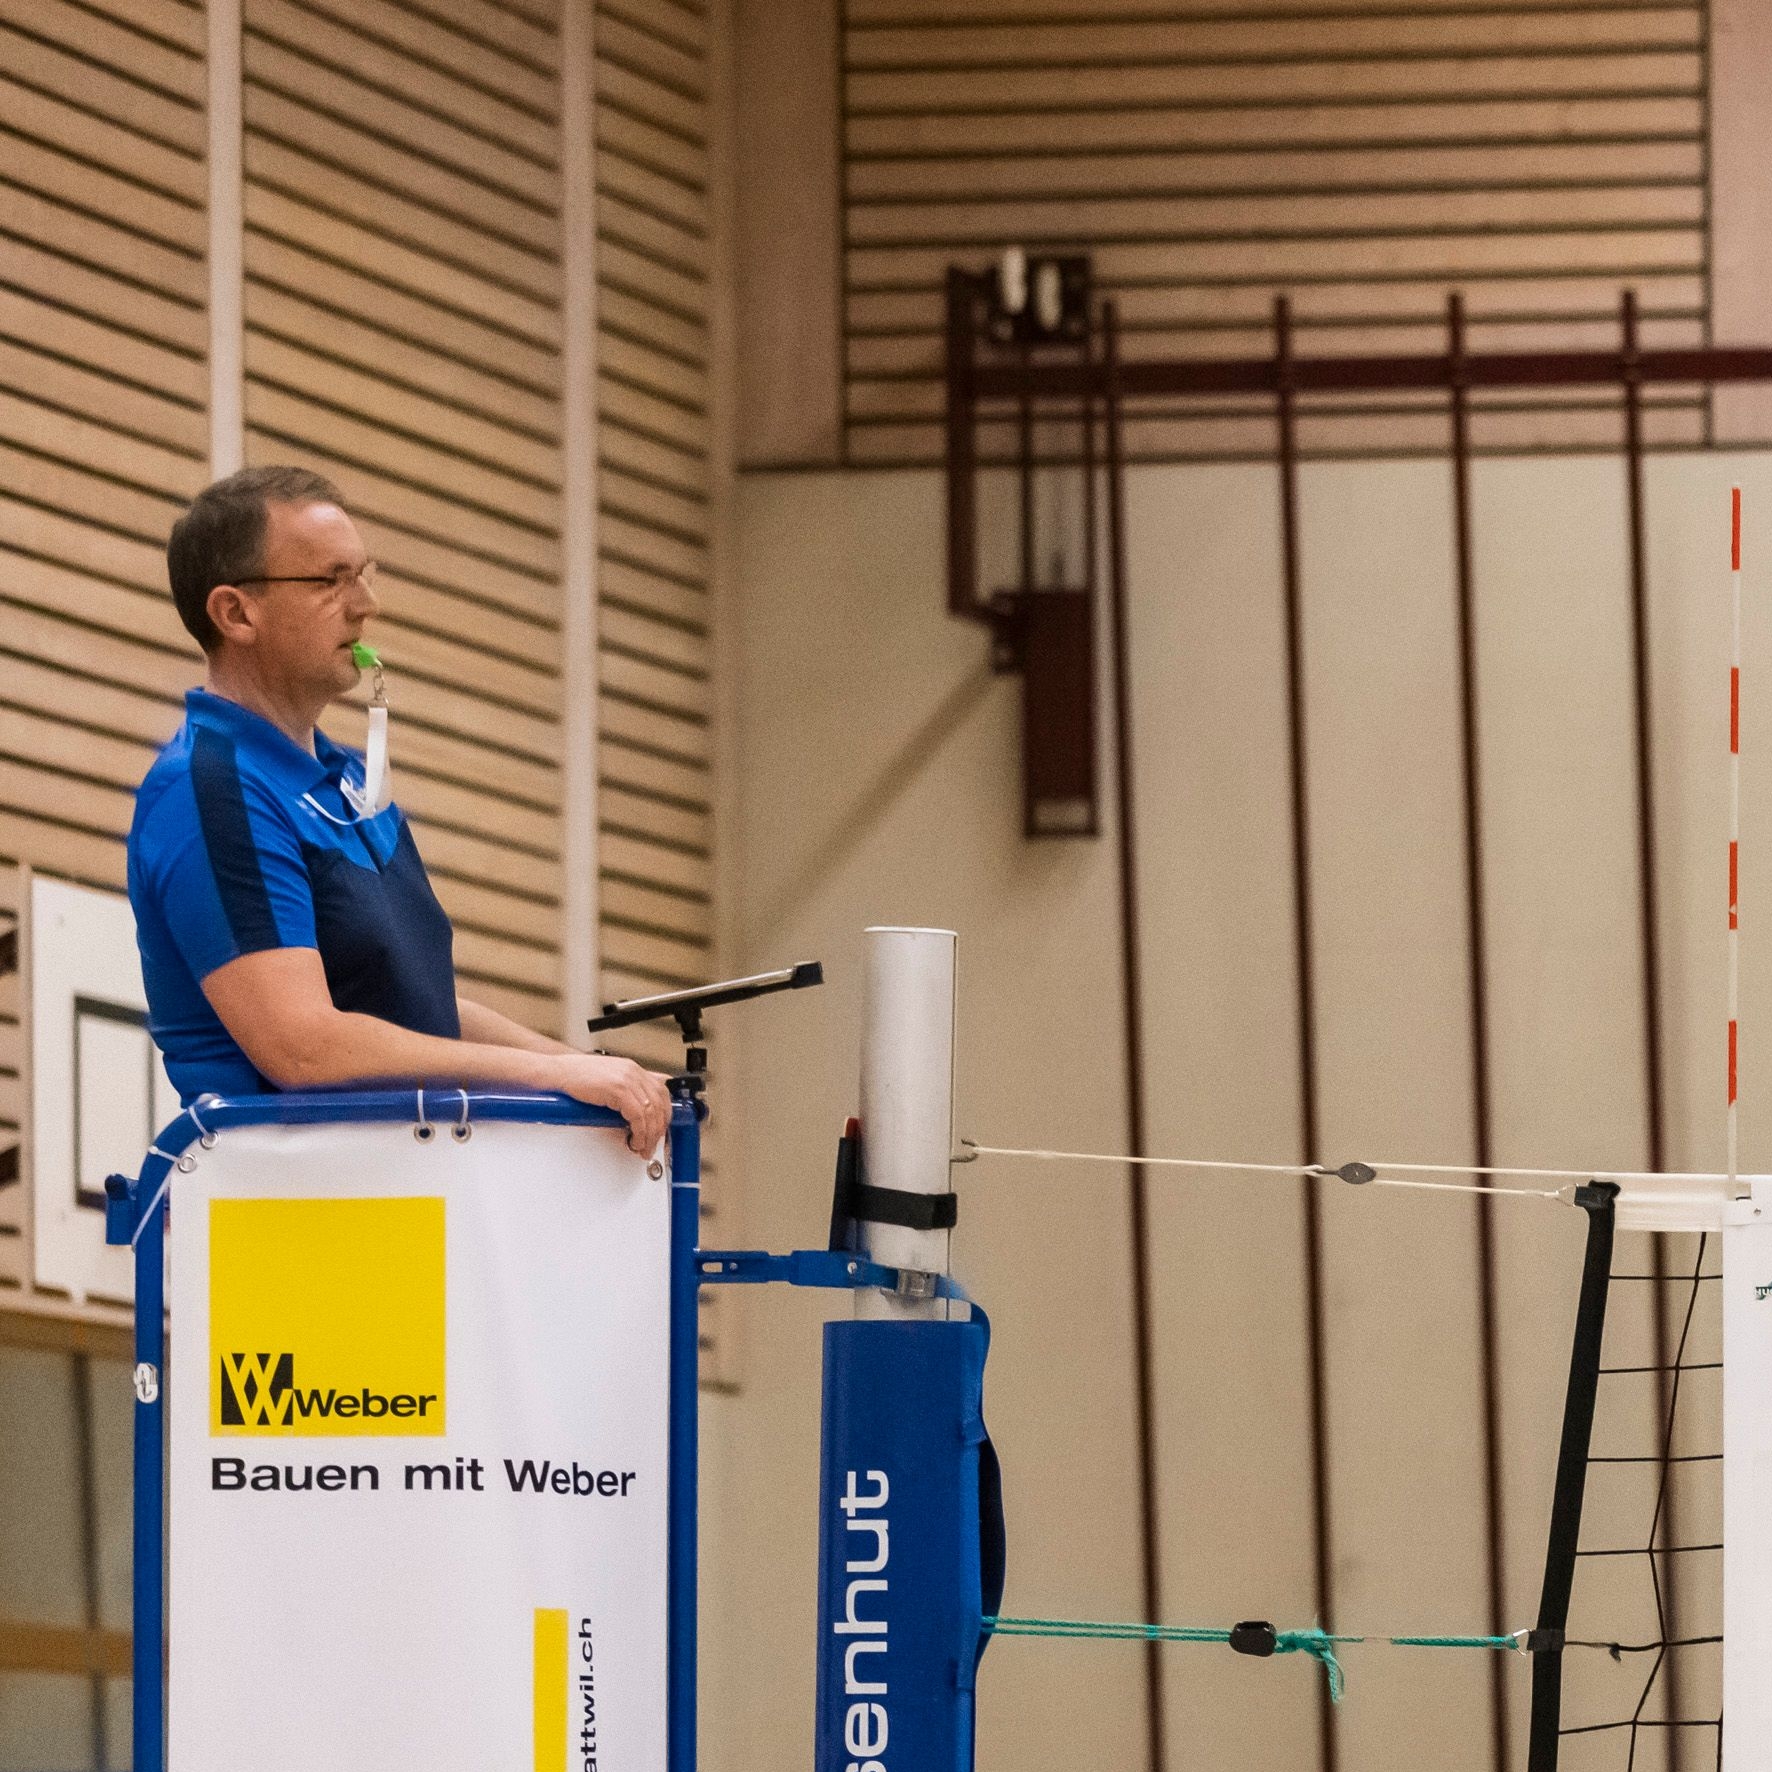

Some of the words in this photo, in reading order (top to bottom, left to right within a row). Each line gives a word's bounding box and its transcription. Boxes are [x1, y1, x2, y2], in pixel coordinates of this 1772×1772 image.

[293, 1388, 437, 1418] Weber
[210, 1456, 380, 1493] Bauen
[402, 1455, 485, 1493] mit
[504, 1458, 637, 1497] Weber
